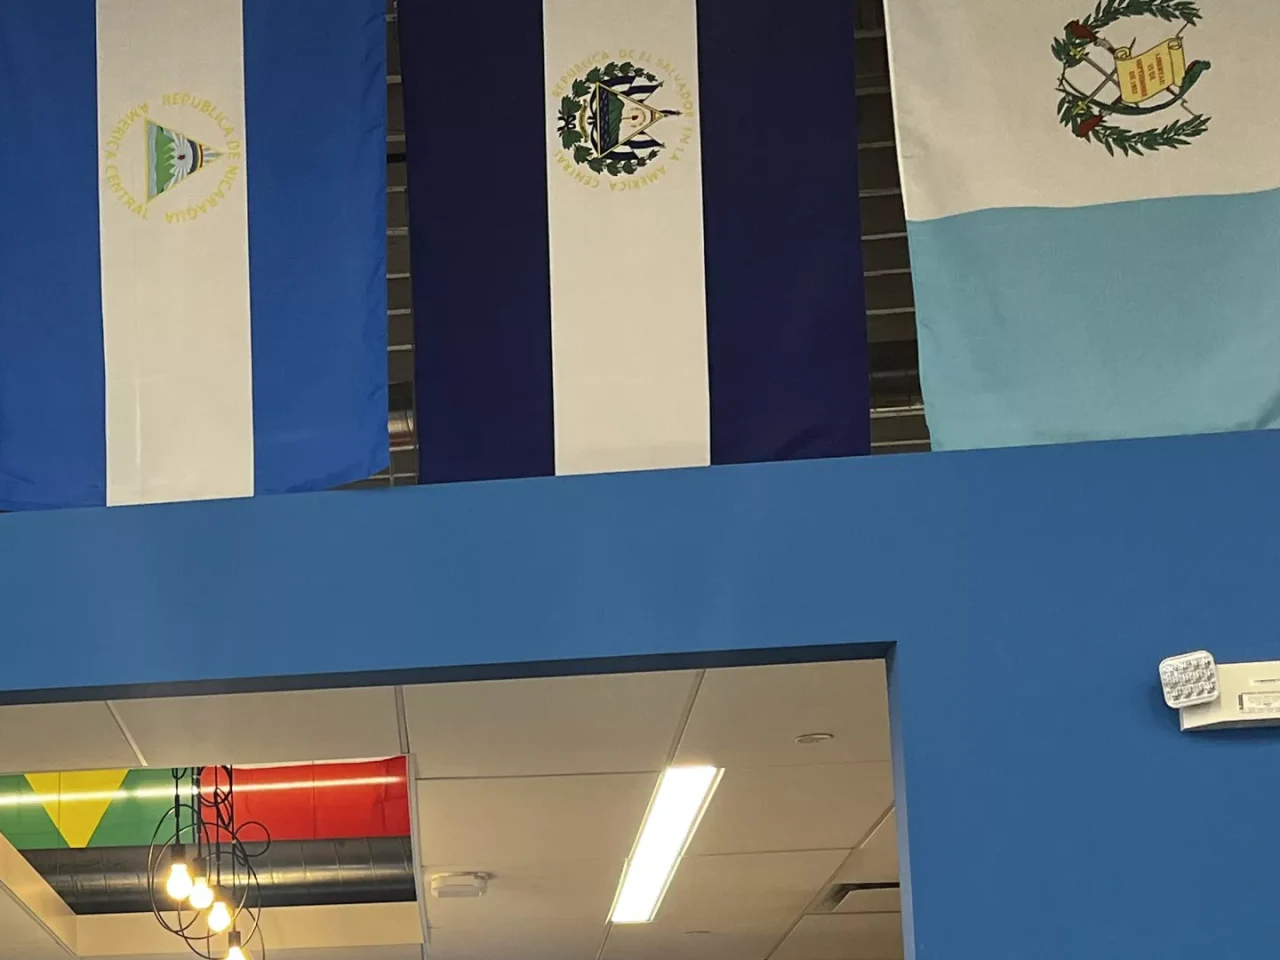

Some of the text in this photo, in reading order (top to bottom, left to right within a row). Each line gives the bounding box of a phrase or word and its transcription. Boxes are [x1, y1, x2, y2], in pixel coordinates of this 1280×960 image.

[106, 103, 149, 220] AMERICA CENTRAL
[162, 93, 241, 224] REPUBLICA DE NICARAGUA
